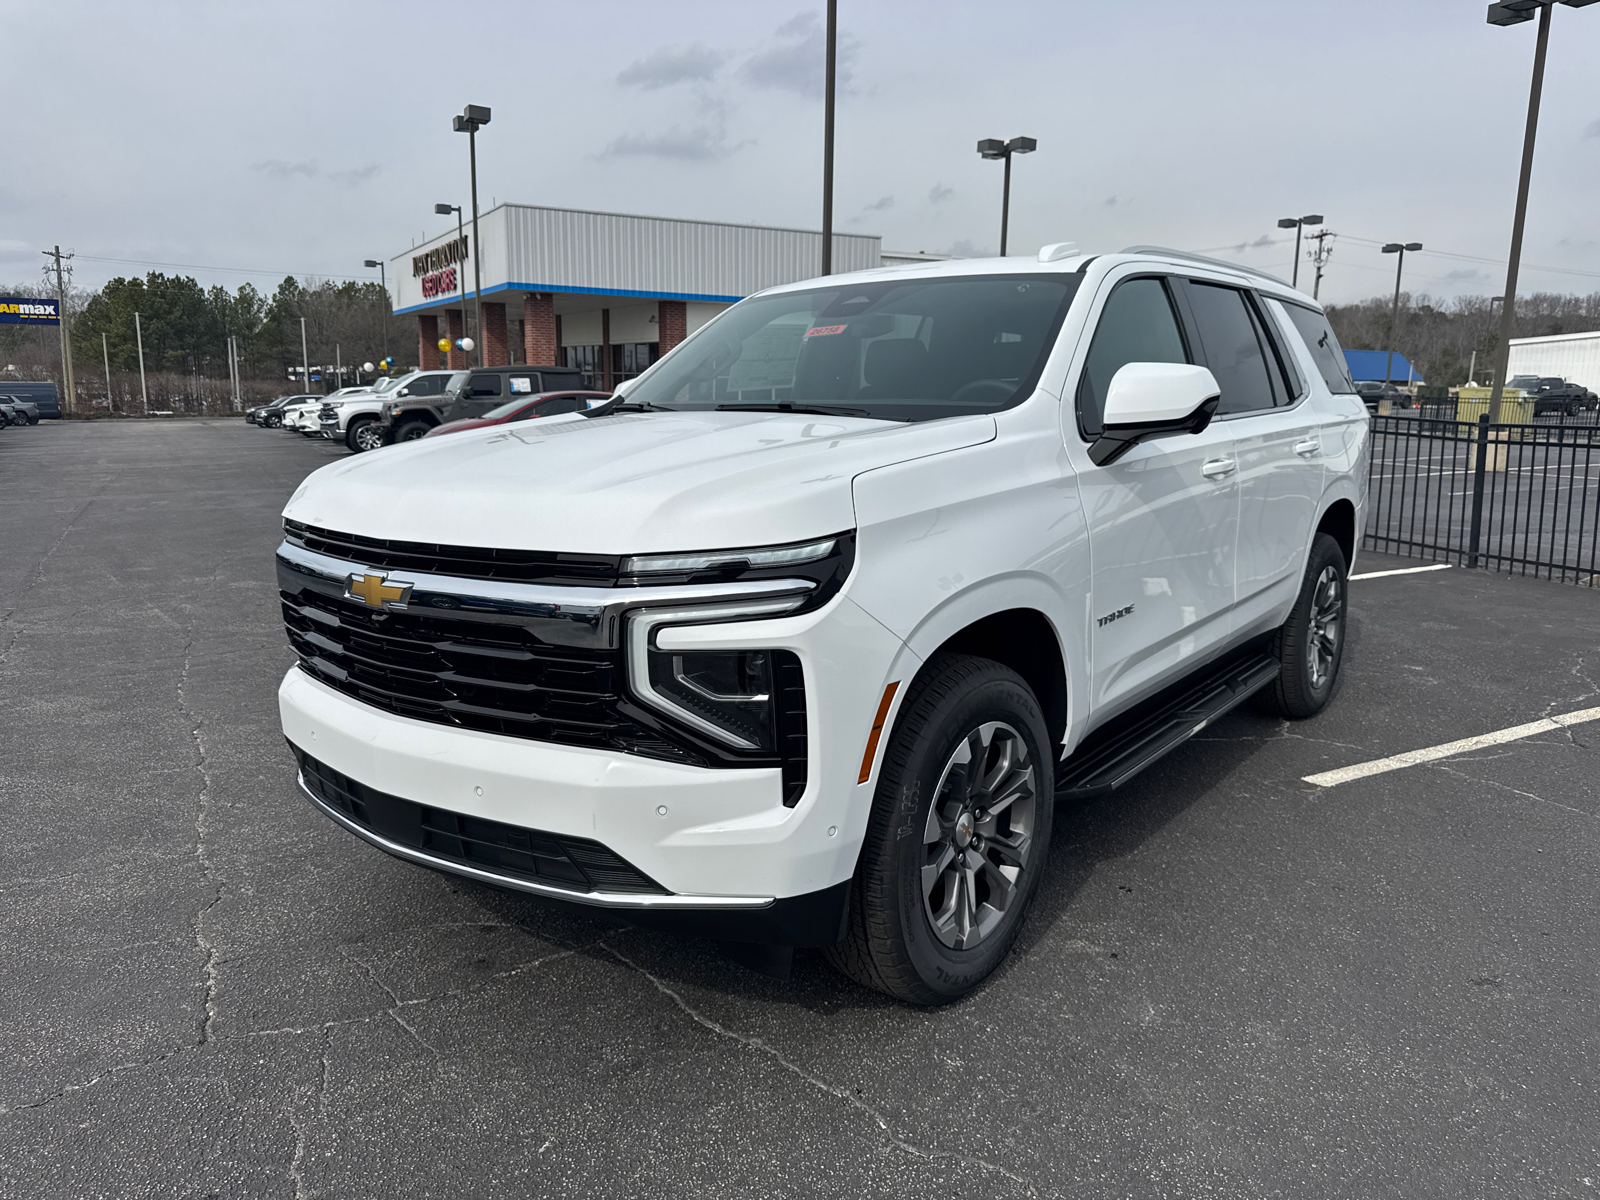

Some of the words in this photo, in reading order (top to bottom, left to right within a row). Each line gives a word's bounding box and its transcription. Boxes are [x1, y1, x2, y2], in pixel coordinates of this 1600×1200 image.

[421, 274, 437, 297] USED
[437, 267, 457, 293] CARS
[1097, 603, 1135, 628] TAHOE
